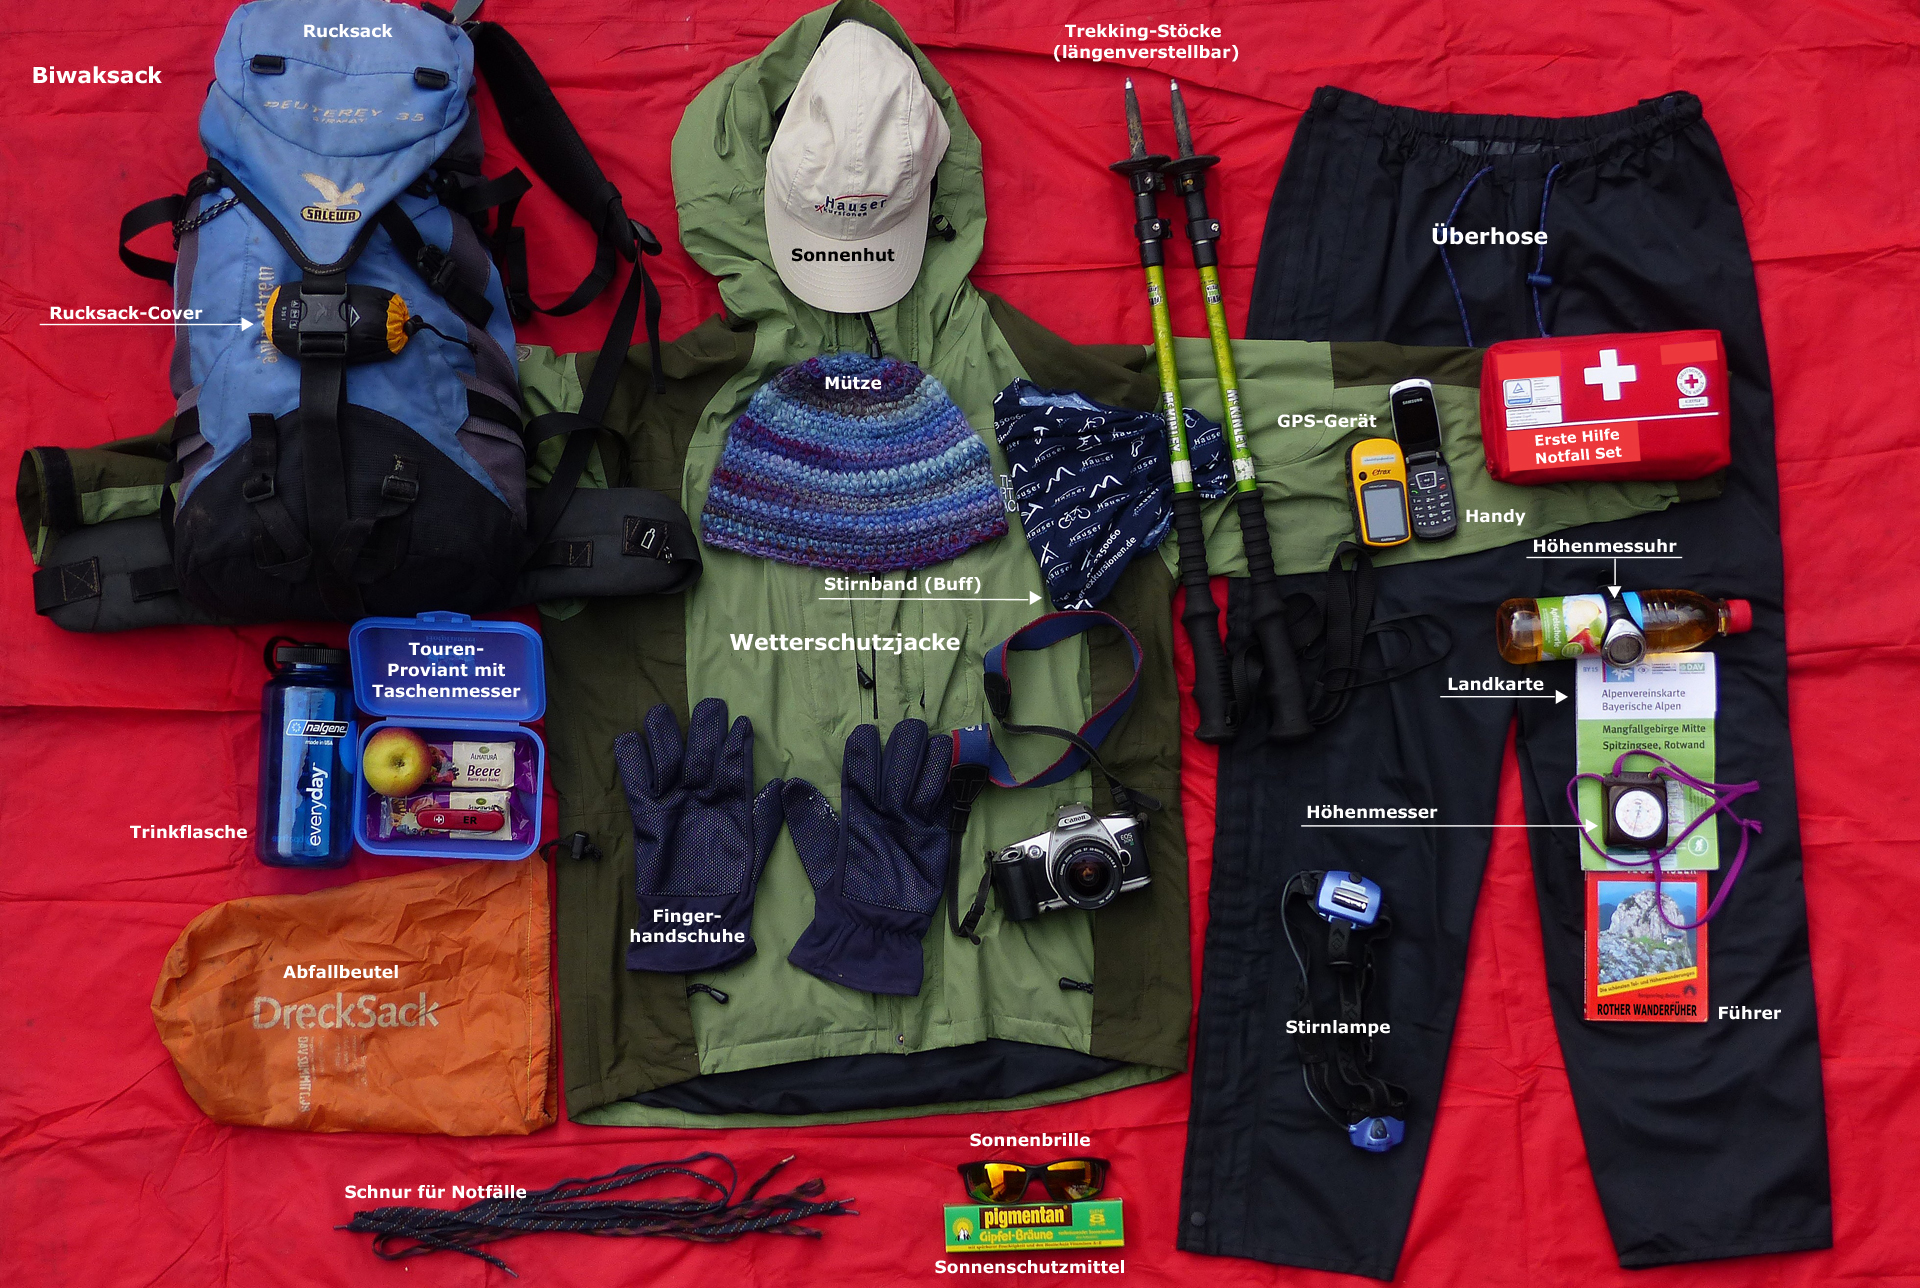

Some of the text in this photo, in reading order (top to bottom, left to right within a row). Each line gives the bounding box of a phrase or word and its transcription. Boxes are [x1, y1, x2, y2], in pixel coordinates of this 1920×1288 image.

[396, 112, 425, 122] 35
[825, 195, 888, 212] Hauser
[306, 209, 356, 221] SALEWA
[1402, 397, 1423, 405] SAMSUNG
[1193, 431, 1221, 446] Hause
[1130, 457, 1158, 473] auser
[1016, 483, 1041, 499] auser
[1026, 520, 1055, 540] Hauser
[1069, 524, 1101, 542] Hauser
[1550, 607, 1562, 648] Apfelschorle
[1602, 689, 1686, 700] Alpenvereinskarte
[1602, 701, 1681, 713] Bayerische Alpen
[306, 722, 346, 735] nalgene
[1602, 724, 1706, 735] Mangfallgebirge Mitte
[1602, 740, 1705, 751] Spitzingsee, Rotwand
[467, 764, 501, 777] Beere
[306, 764, 329, 846] everyday
[1064, 815, 1086, 824] Canon
[1120, 833, 1133, 841] EOS
[253, 991, 440, 1030] DreckSack
[297, 1036, 309, 1055] DAV
[984, 1206, 1065, 1229] pigmentan
[979, 1229, 1054, 1244] Gipfel-Bräune
